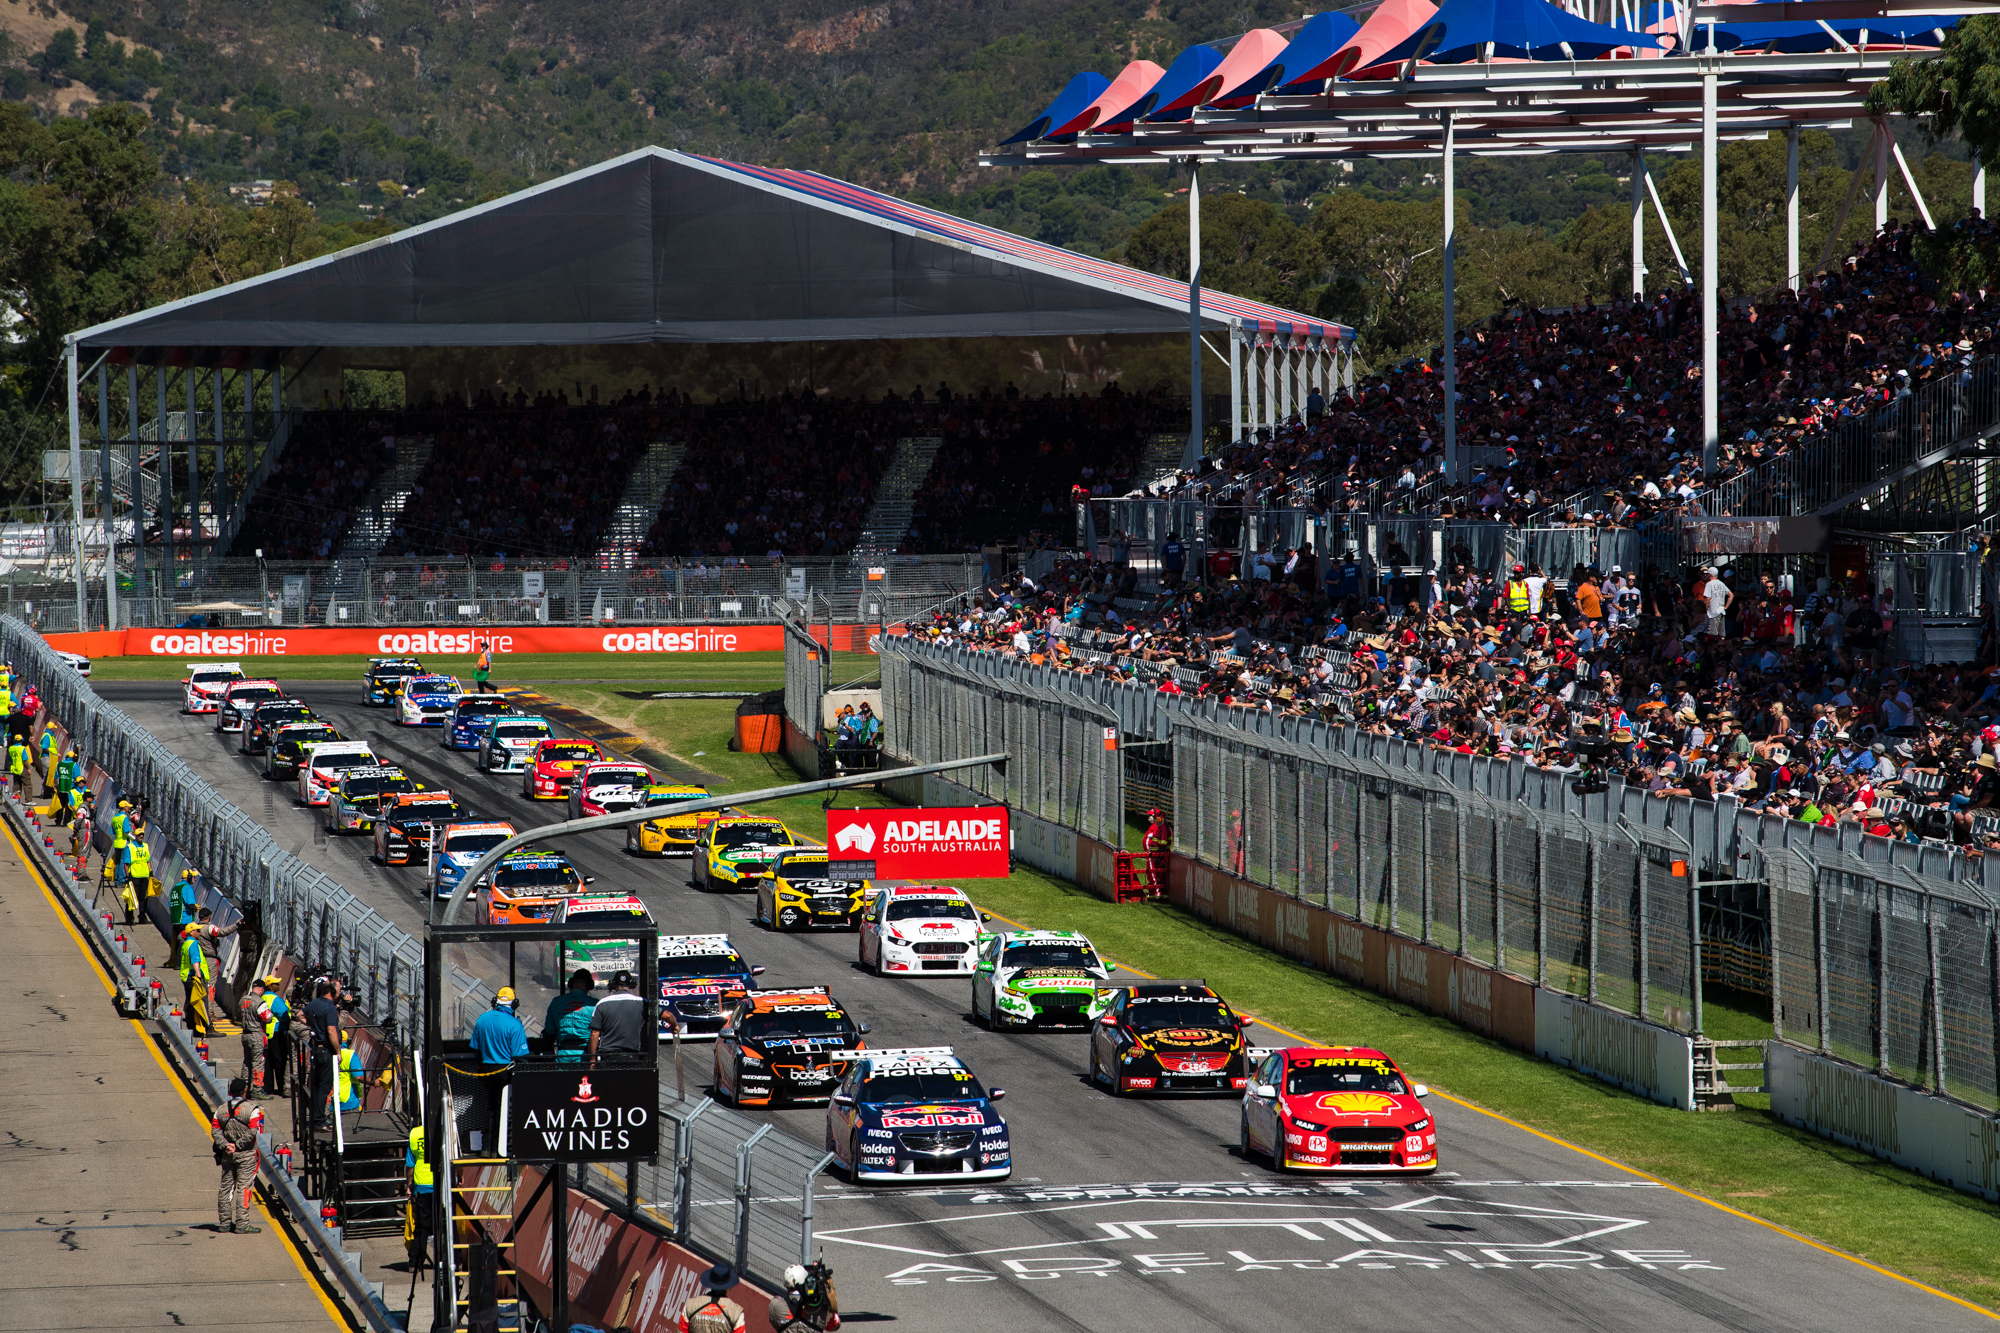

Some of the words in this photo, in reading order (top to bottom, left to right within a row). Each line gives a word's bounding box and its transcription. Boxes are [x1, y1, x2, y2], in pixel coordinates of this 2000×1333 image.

[151, 631, 286, 654] coateshire
[602, 629, 737, 652] coateshire
[884, 819, 1002, 842] ADELAIDE
[884, 842, 926, 854] SOUTH
[932, 841, 1002, 853] AUSTRALIA
[512, 862, 558, 870] Mobil
[570, 904, 641, 912] NISSAN
[1338, 922, 1364, 963] ADELAIDE
[592, 961, 633, 971] Steadfast
[1400, 944, 1428, 987] ADELAIDE
[1038, 979, 1093, 988] Castrol
[1462, 967, 1492, 1010] ADELAIDE
[661, 986, 706, 997] Red
[746, 986, 826, 998] boost
[1130, 994, 1219, 1004] erebus
[774, 1004, 837, 1012] boost
[1218, 1008, 1227, 1016] 9
[1141, 1029, 1234, 1040] PENRITE
[764, 1038, 844, 1048] Mobil
[878, 1060, 953, 1069] CALTEX
[1314, 1058, 1387, 1068] PIRTEK
[790, 1068, 829, 1080] boost
[870, 1067, 968, 1078] Holden
[1374, 1067, 1390, 1076] 17
[954, 1074, 969, 1082] 97
[524, 1107, 647, 1130] AMADIO
[881, 1114, 935, 1128] Red
[935, 1113, 984, 1127] Bull
[982, 1125, 1002, 1136] IVECO
[1296, 1120, 1315, 1131] MAN
[867, 1128, 893, 1138] IVECO
[542, 1130, 630, 1151] WINES
[860, 1142, 896, 1154] Holden
[860, 1156, 884, 1166] CALTEX
[1293, 1152, 1327, 1164] SHARP
[885, 1249, 1711, 1279] ADELAIDE
[890, 1267, 1188, 1286] SOUTH
[1236, 1262, 1726, 1272] AUSTRALIA
